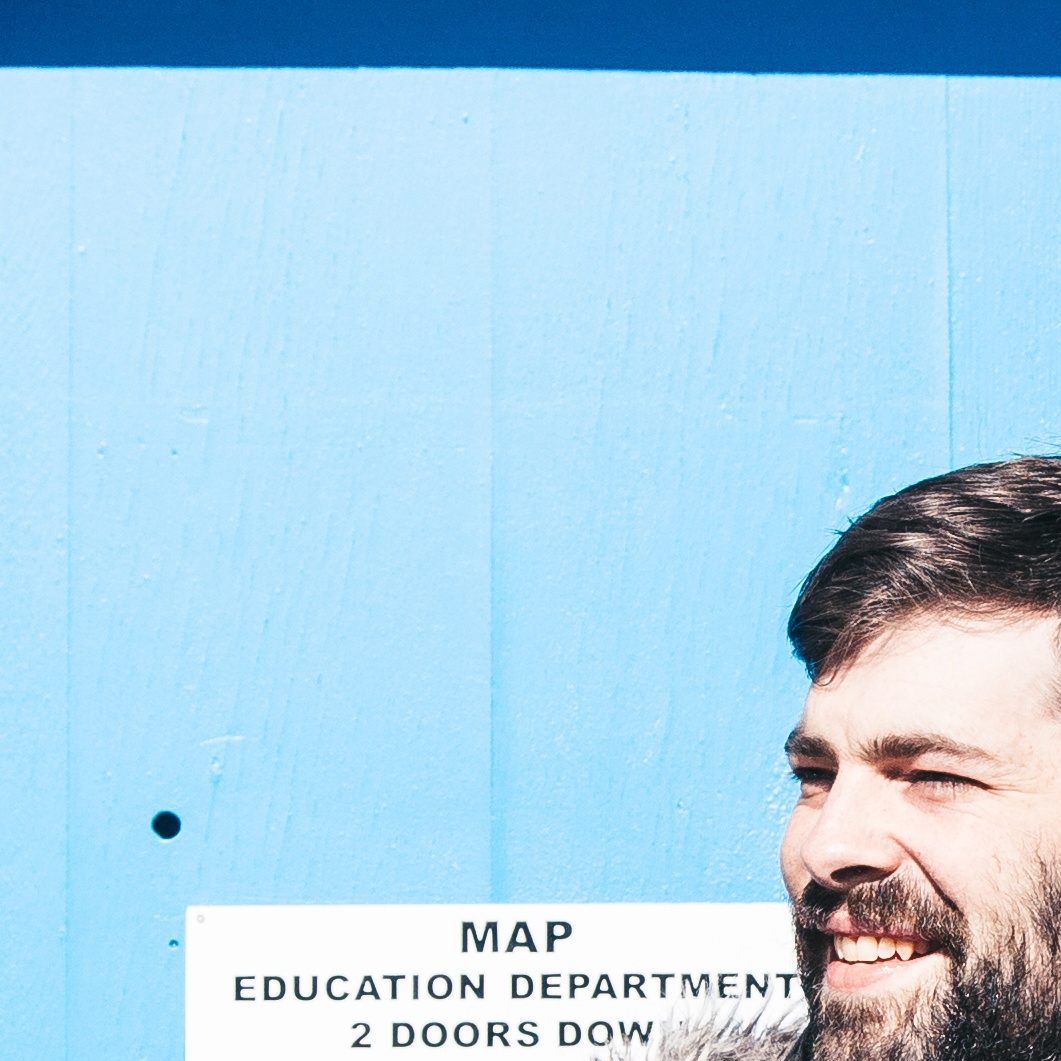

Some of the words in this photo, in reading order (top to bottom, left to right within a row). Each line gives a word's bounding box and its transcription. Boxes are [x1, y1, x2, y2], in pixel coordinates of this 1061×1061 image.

[461, 921, 573, 953] MAP
[234, 974, 486, 1001] EDUCATION
[510, 973, 798, 999] DEPARTMENT
[351, 1022, 372, 1048] 2
[392, 1021, 539, 1048] DOORS
[558, 1020, 683, 1047] DOW
